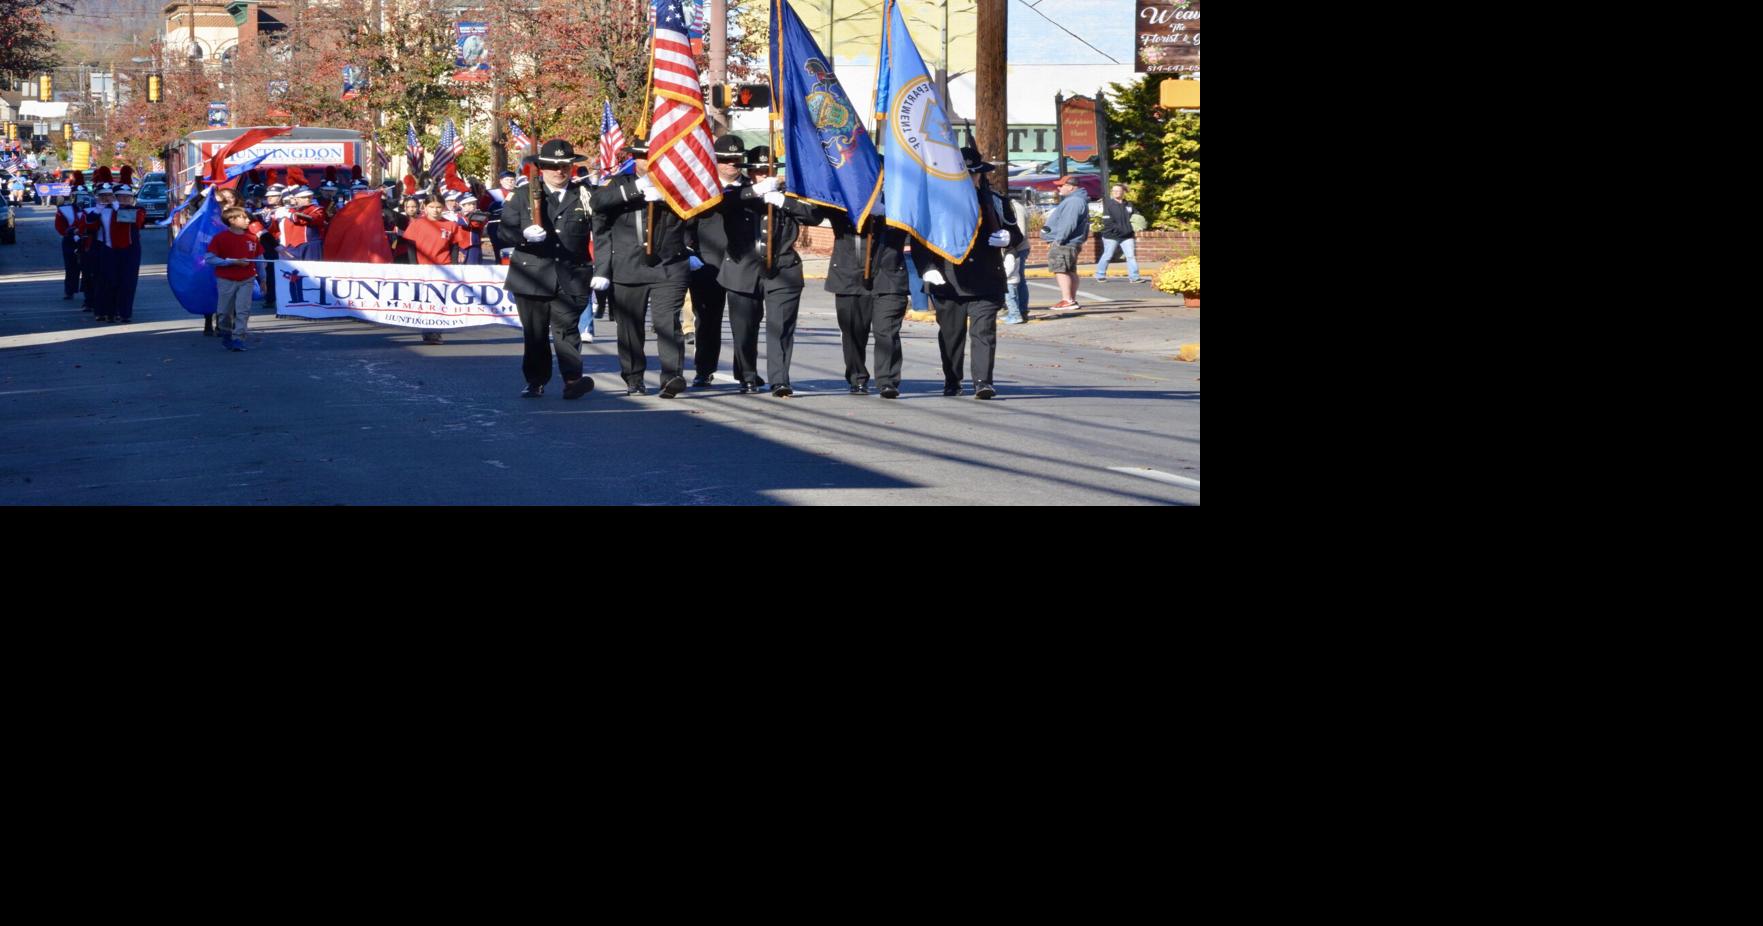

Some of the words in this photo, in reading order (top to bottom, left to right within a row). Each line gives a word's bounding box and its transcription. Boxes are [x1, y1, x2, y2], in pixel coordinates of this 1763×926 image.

[1169, 23, 1185, 32] The
[1141, 33, 1182, 45] Florist
[334, 300, 381, 308] AREA
[385, 314, 450, 326] HUNTINGDON
